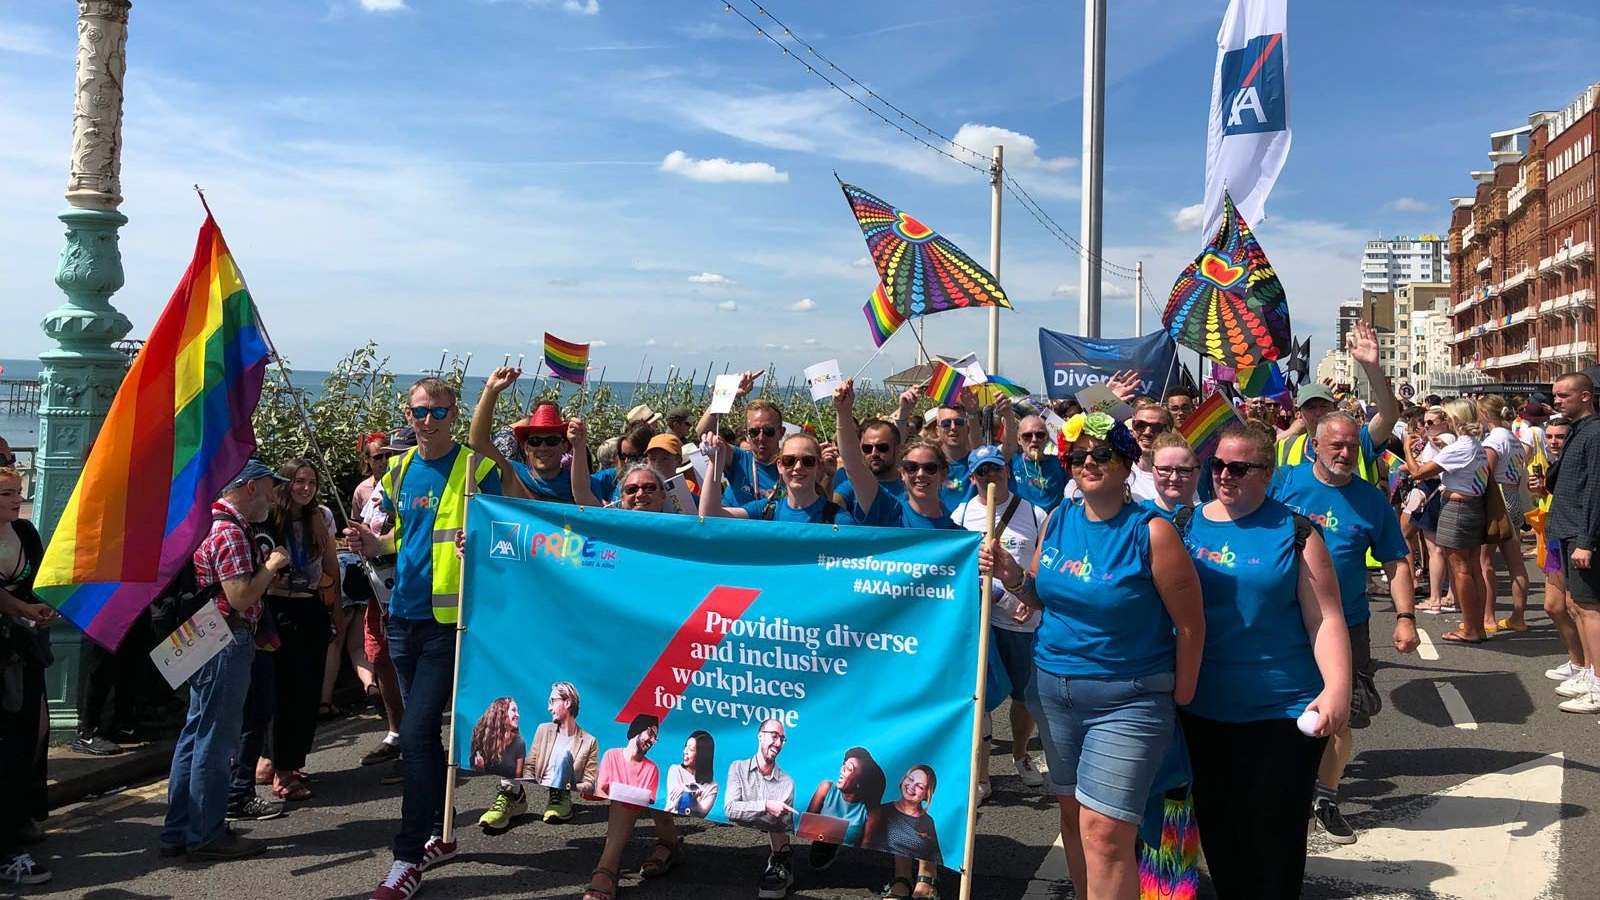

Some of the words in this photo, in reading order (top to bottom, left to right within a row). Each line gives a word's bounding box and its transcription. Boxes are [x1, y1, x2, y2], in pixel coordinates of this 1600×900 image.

[1054, 368, 1153, 395] Divery
[490, 540, 516, 556] AXA
[531, 527, 597, 559] PRIDE
[600, 548, 616, 560] UK
[817, 553, 956, 578] #pressforprogress
[853, 578, 956, 600] #AXAprideuk
[704, 610, 821, 650] Providing
[826, 623, 919, 655] diverse
[690, 641, 734, 664] and
[738, 642, 849, 676] inclusive
[672, 666, 806, 700] workplaces
[654, 685, 687, 710] for
[691, 696, 799, 729] everyone
